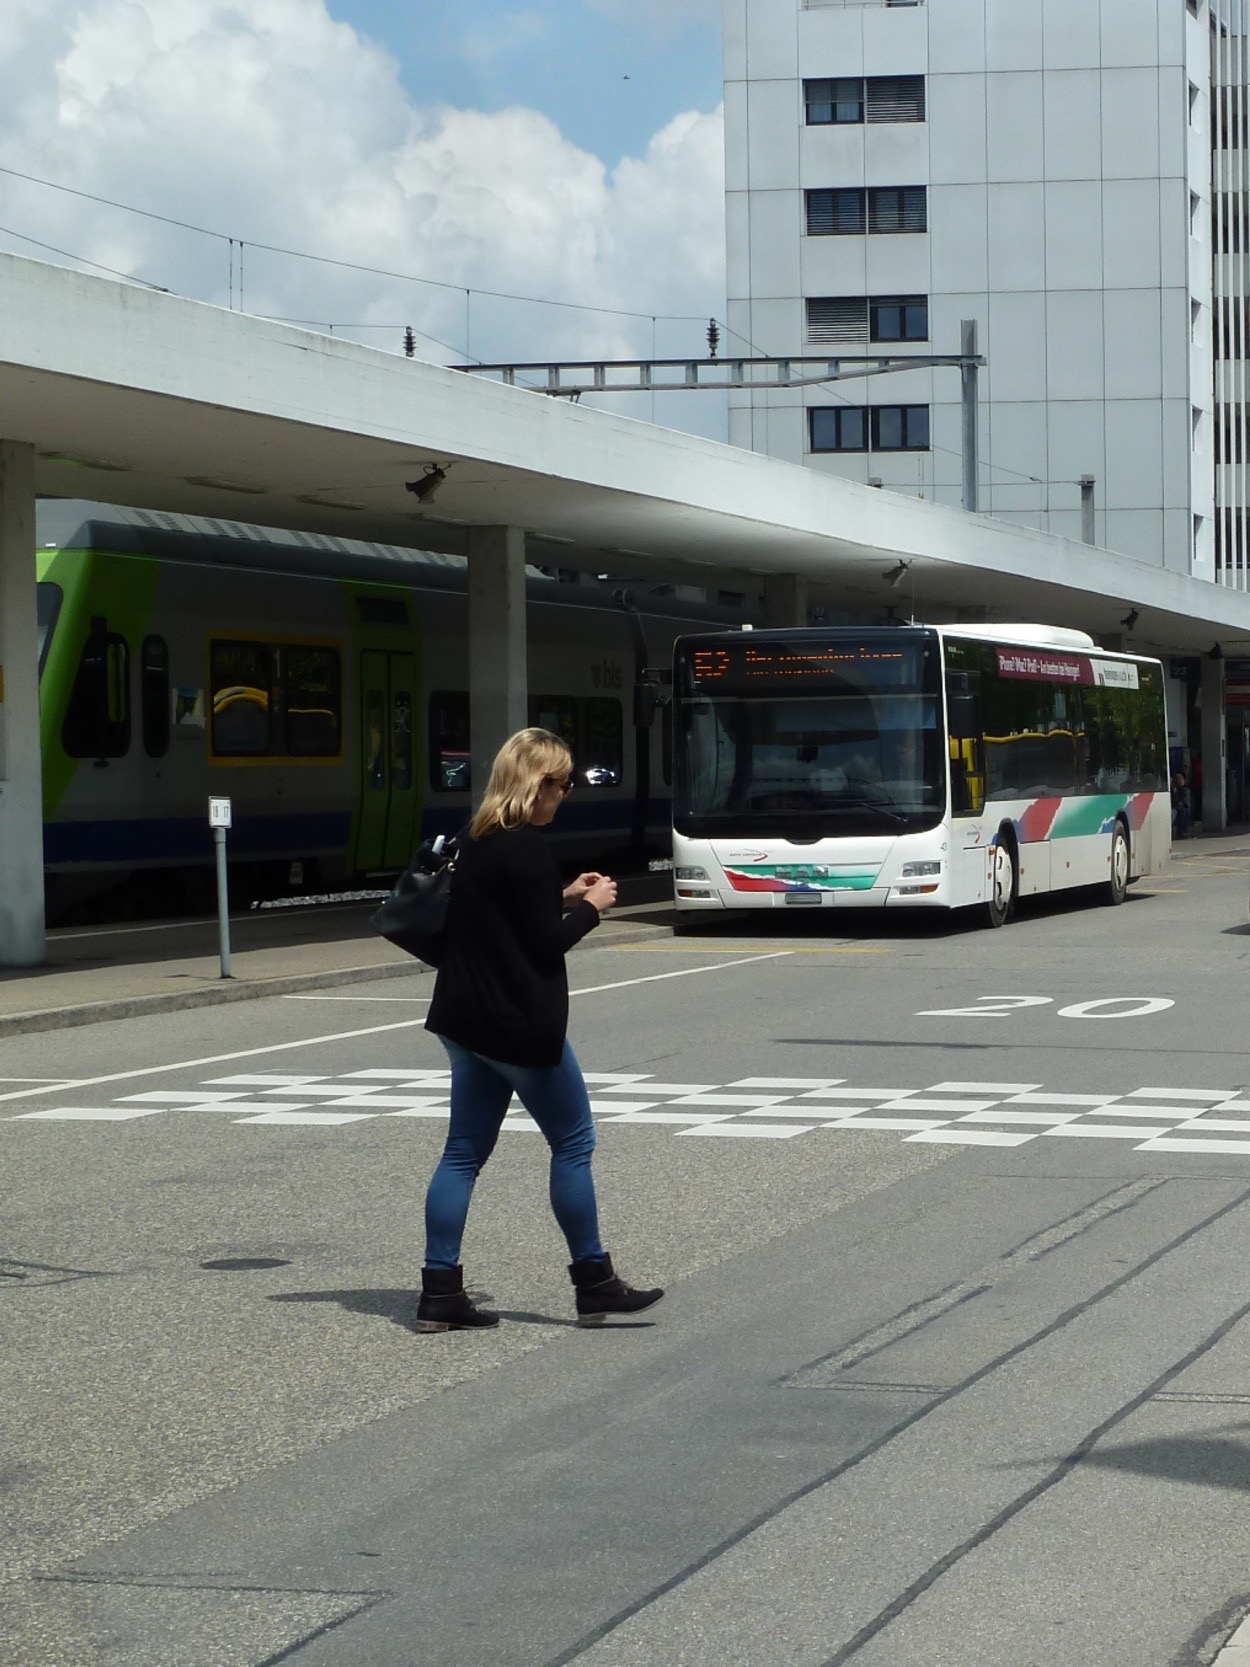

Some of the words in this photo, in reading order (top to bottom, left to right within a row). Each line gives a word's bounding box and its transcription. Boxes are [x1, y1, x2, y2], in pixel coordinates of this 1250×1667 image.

[603, 657, 622, 689] bls
[775, 865, 829, 880] MAN
[913, 995, 1176, 1019] 20
